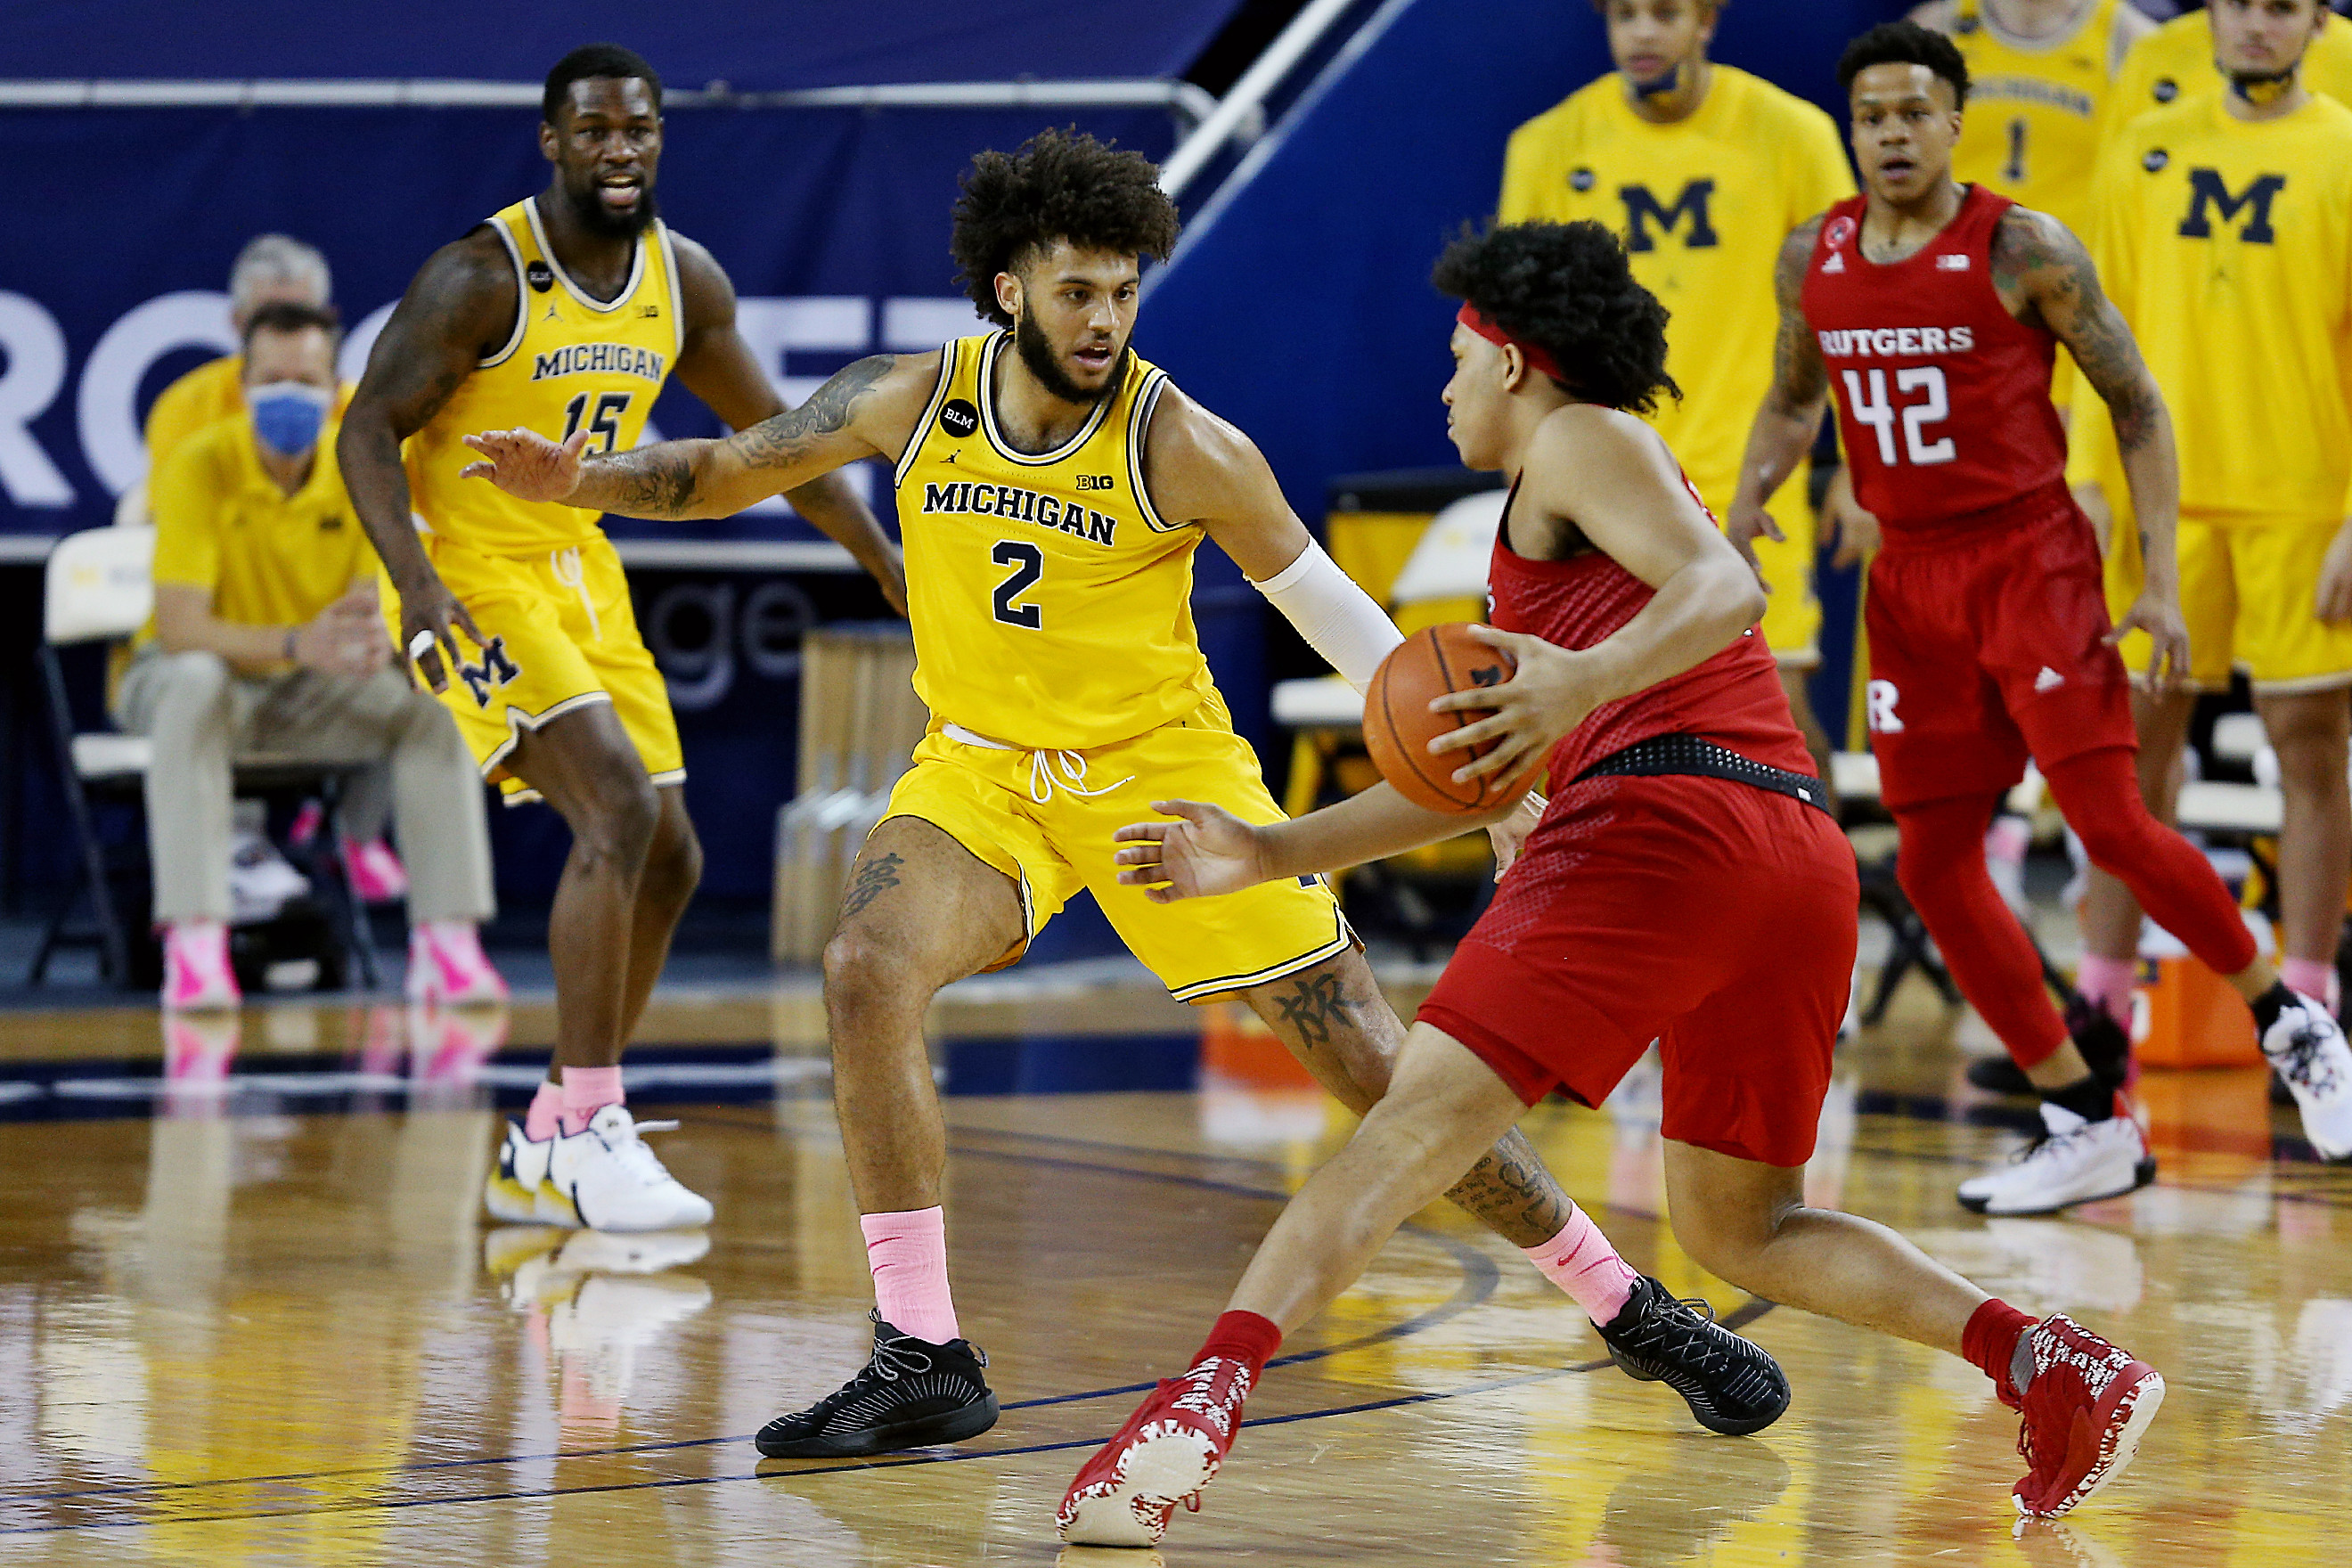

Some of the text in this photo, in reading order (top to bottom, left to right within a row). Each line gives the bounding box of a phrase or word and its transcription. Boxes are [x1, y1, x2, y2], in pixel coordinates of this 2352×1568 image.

[1618, 180, 1719, 252] M
[2178, 166, 2287, 244] M
[531, 342, 666, 384] MICHIGAN
[1818, 326, 1976, 356] RUTGERS
[561, 390, 634, 457] 15
[943, 407, 975, 429] BLM
[1842, 365, 1957, 467] 42
[922, 482, 1118, 548] MICHIGAN
[991, 539, 1045, 631] 2
[461, 634, 523, 710] M
[1866, 679, 1906, 735] R
